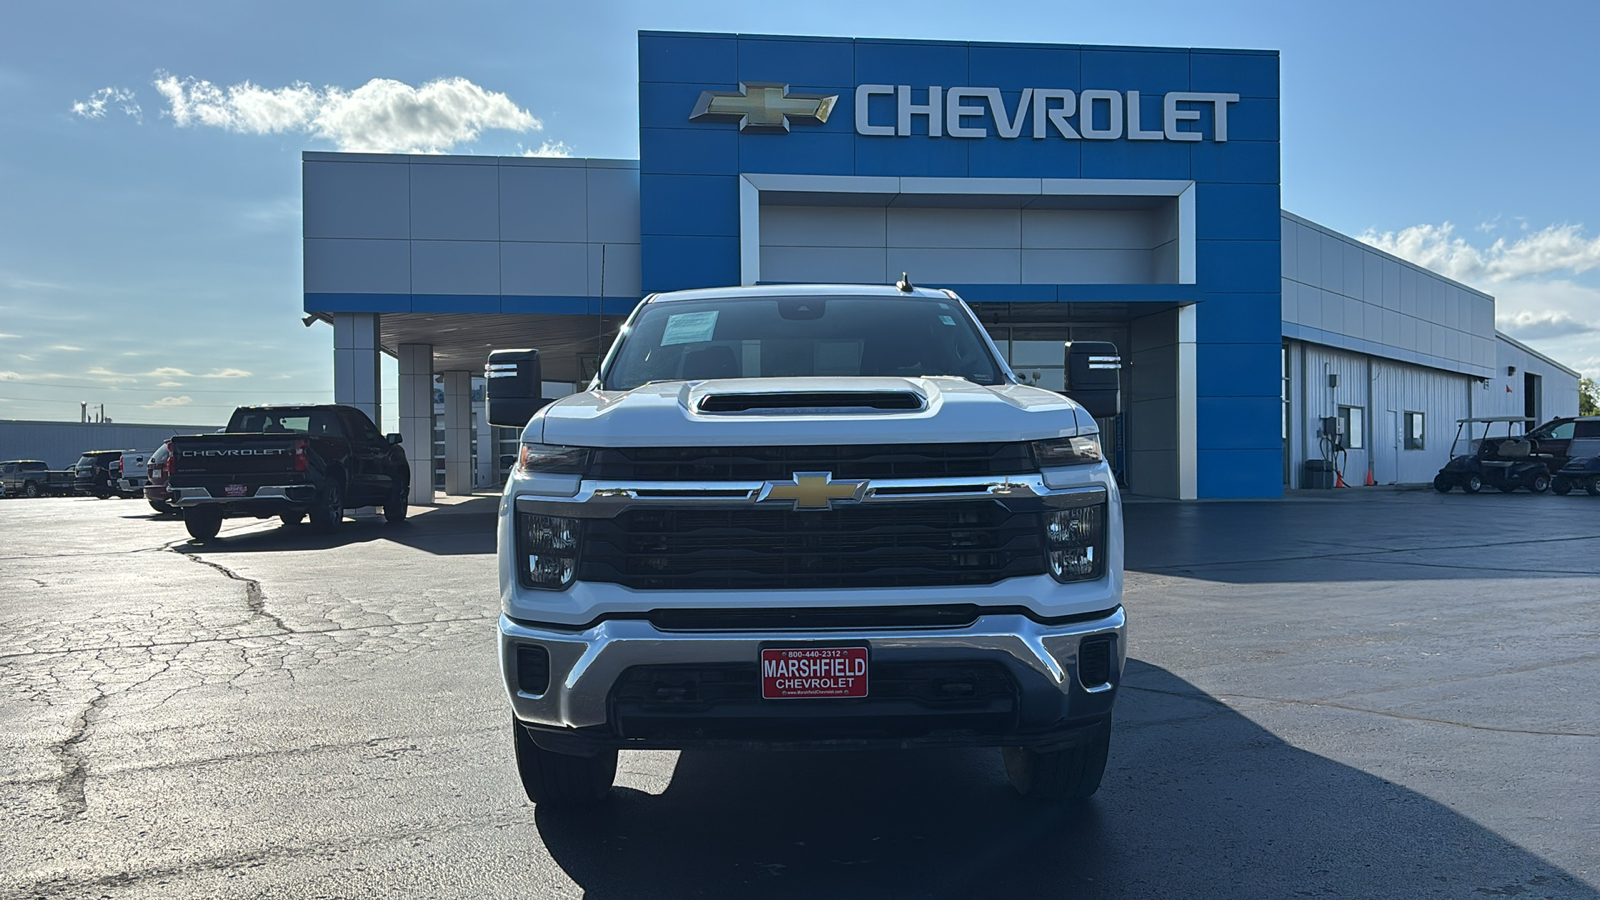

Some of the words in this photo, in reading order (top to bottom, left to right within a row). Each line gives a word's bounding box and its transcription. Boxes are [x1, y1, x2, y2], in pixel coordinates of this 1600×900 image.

[855, 84, 1240, 142] CHEVROLET
[182, 448, 286, 457] CHEVROLET
[764, 659, 865, 677] MARSHFIELD
[776, 678, 854, 688] CHEVROLET
